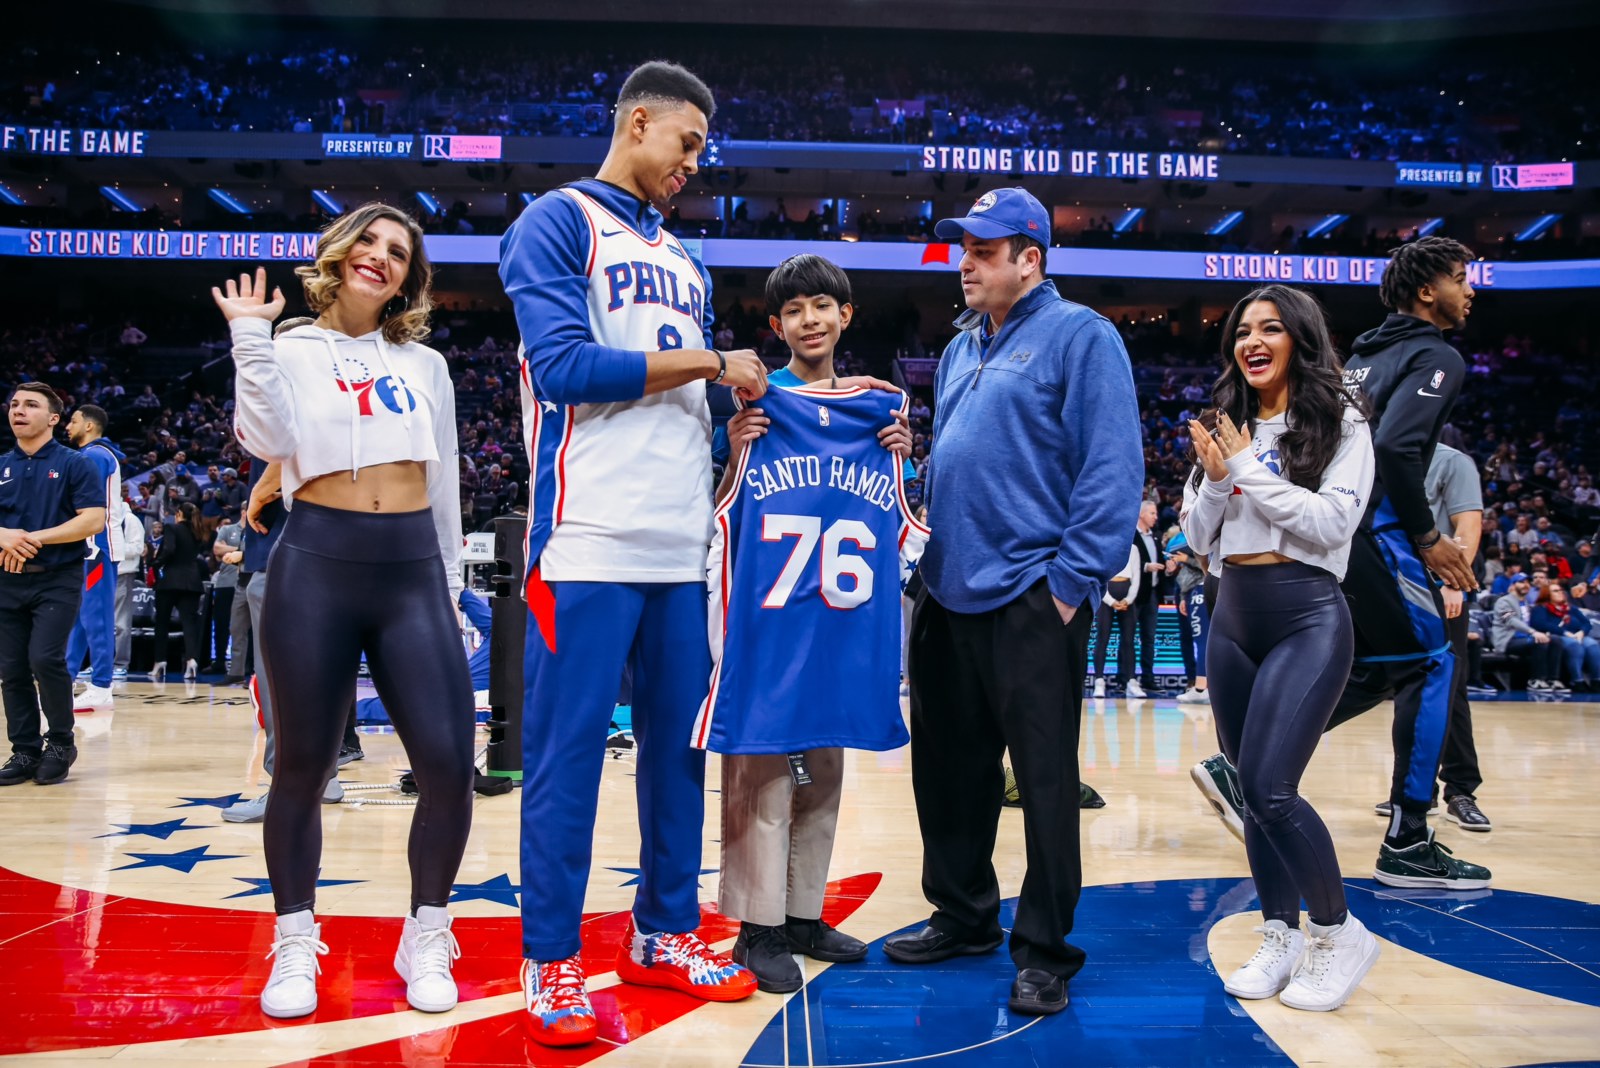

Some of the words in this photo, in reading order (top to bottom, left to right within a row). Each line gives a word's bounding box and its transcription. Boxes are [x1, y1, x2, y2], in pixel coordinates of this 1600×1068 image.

[3, 127, 17, 149] F
[29, 129, 71, 152] THE
[83, 131, 144, 154] GAME
[327, 140, 393, 153] PRESENTED
[397, 141, 413, 154] BY
[430, 135, 451, 159] R
[923, 146, 1013, 171] STRONG
[1024, 150, 1060, 172] KID
[1071, 151, 1098, 174] OF
[1108, 152, 1149, 175] THE
[1159, 154, 1219, 178] GAME
[1399, 168, 1464, 183] PRESENTED
[1466, 170, 1482, 184] BY
[1498, 166, 1518, 189] R
[29, 231, 121, 255] STRONG
[132, 232, 170, 256] KID
[181, 233, 208, 257] OF
[219, 234, 260, 257] THE
[271, 234, 318, 258] GAM
[1205, 255, 1293, 279] STRONG
[1303, 257, 1336, 281] KID
[1349, 259, 1376, 283] OF
[1465, 263, 1494, 286] ME
[604, 260, 704, 334] PHILA
[335, 376, 417, 416] 76
[745, 455, 820, 501] SANTO
[828, 455, 896, 512] RAMOS
[760, 513, 877, 611] 76
